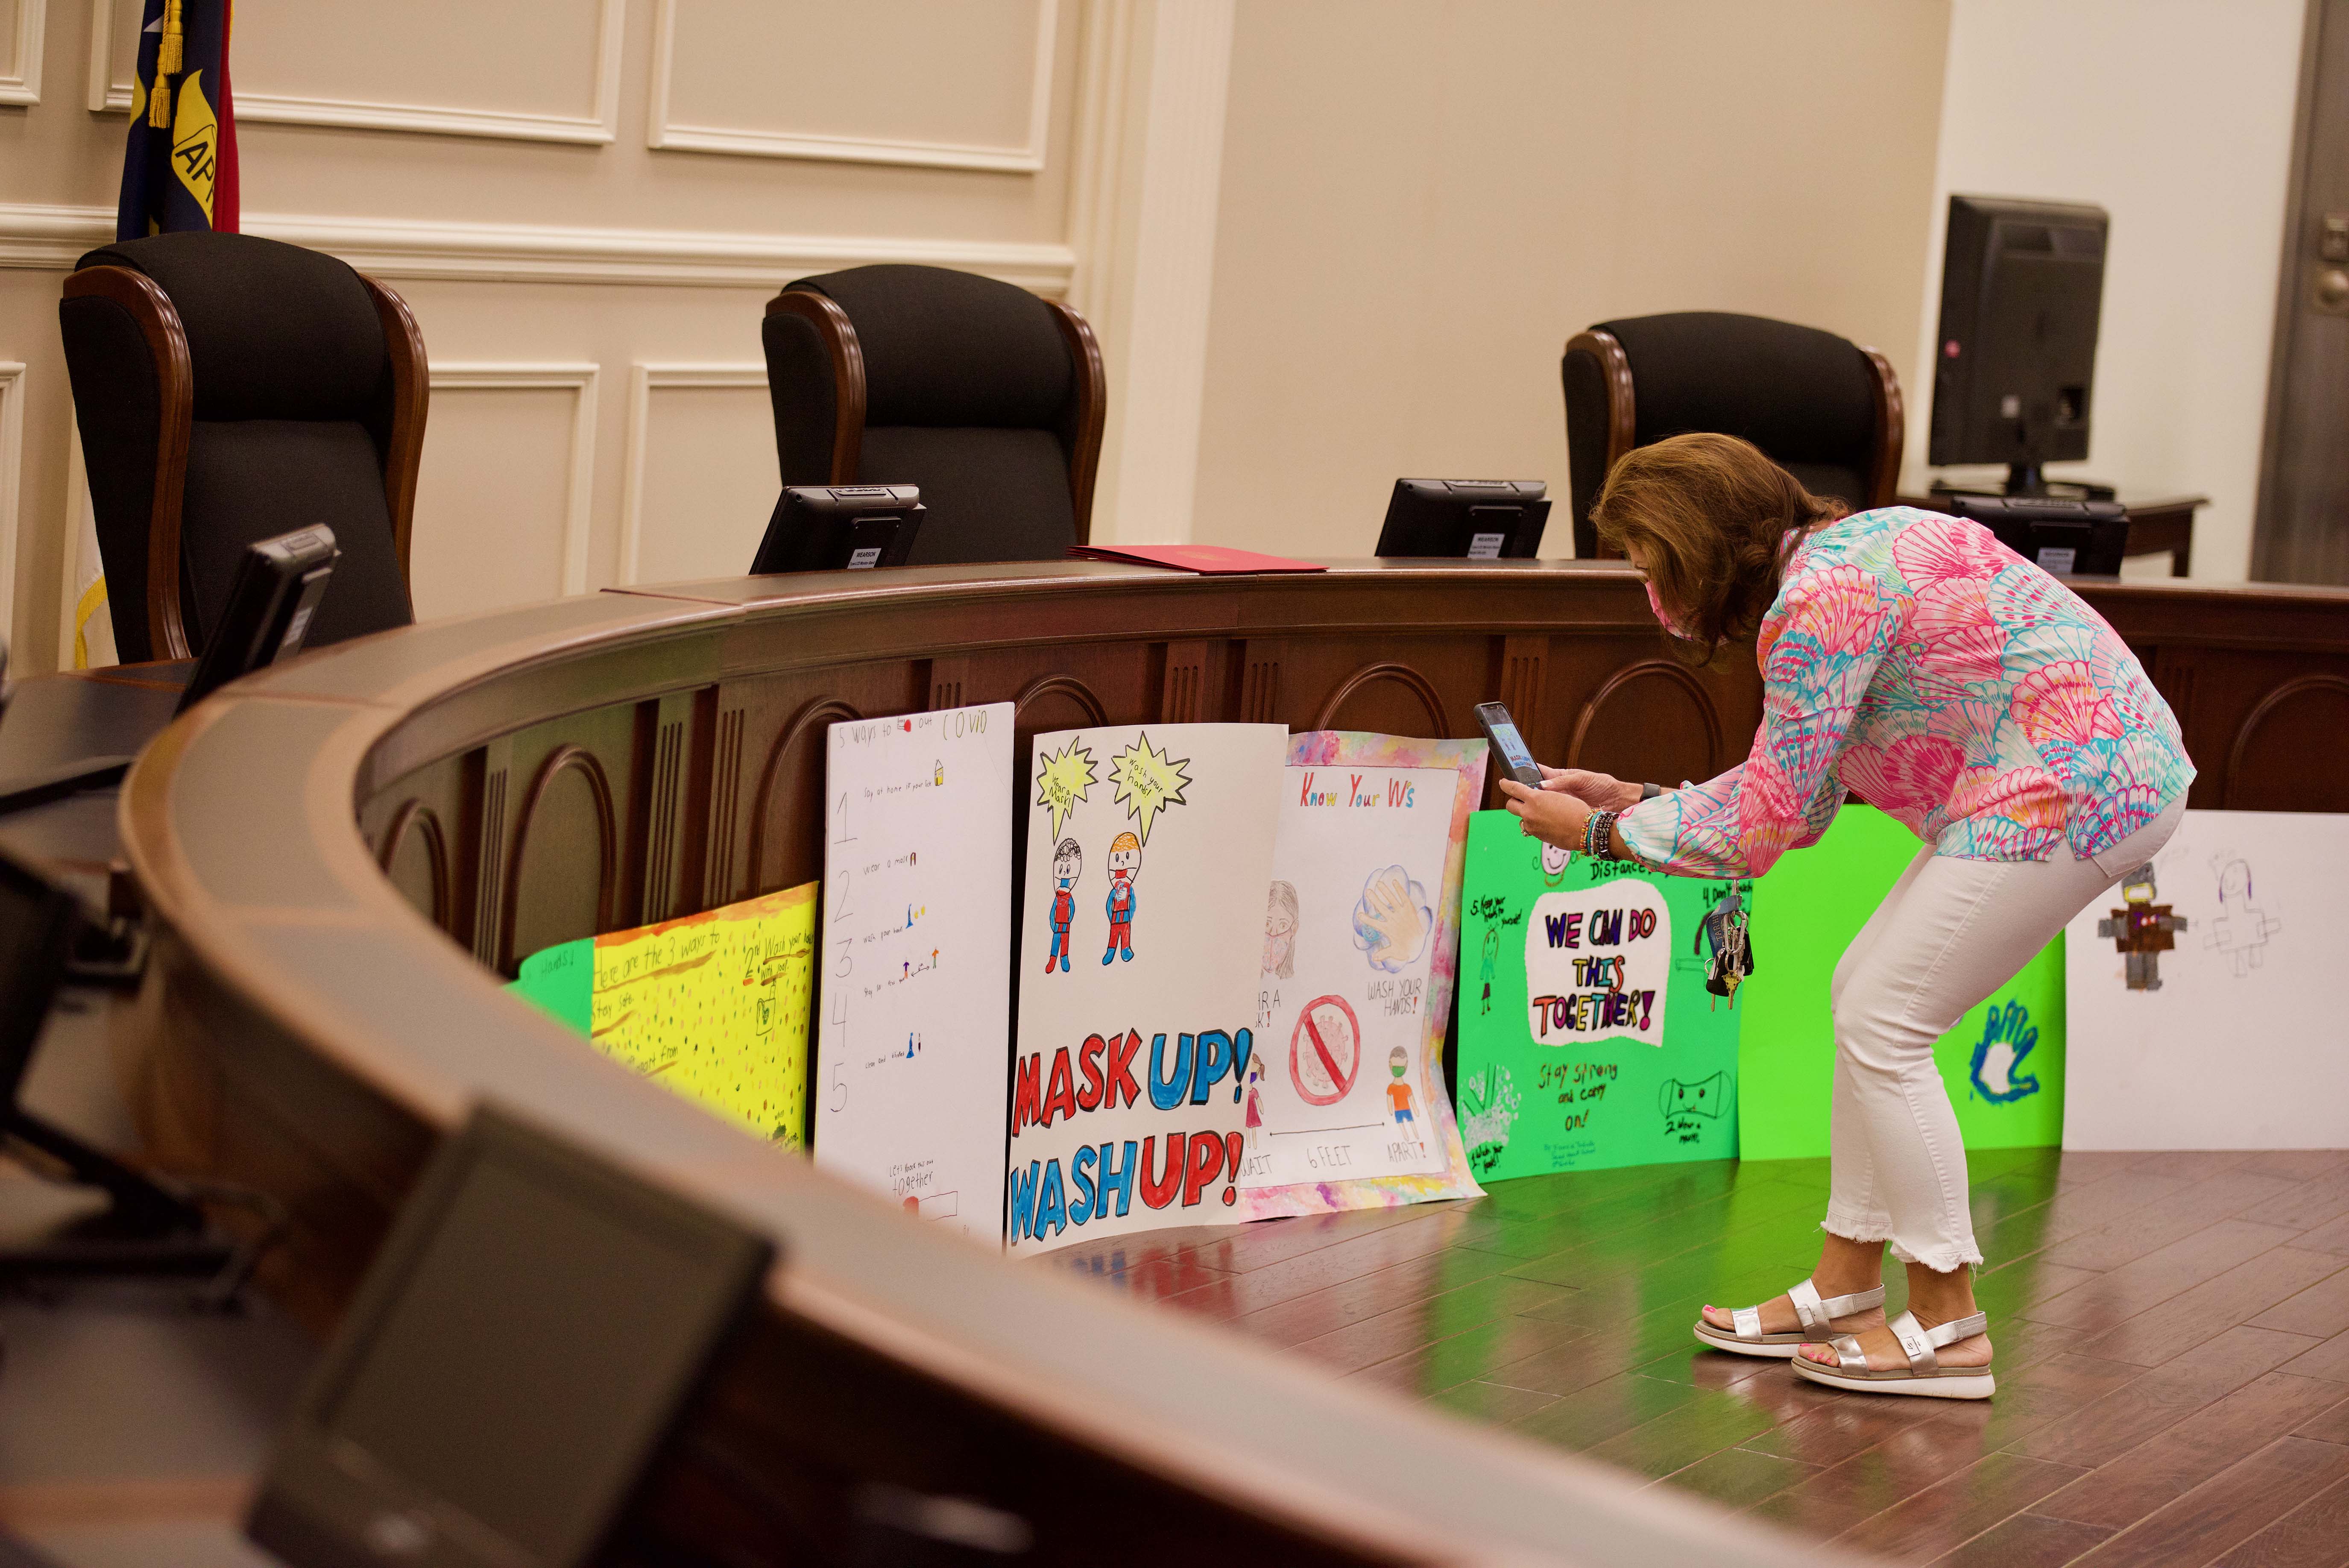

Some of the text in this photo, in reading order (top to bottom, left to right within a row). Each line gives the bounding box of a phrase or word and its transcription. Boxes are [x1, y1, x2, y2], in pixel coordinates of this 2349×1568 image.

[839, 727, 844, 748] 5
[883, 724, 891, 737] to
[919, 717, 933, 728] out
[1147, 777, 1163, 793] your
[1300, 772, 1415, 808] Know Your W's
[834, 792, 858, 844] 1
[877, 787, 883, 796] at
[913, 783, 923, 791] your
[834, 870, 853, 923] 2
[887, 859, 891, 868] a
[1545, 908, 1657, 949] WE CAN DO
[1713, 926, 1723, 941] TAR
[593, 924, 721, 989] Here are the 3 ways to
[835, 938, 852, 978] 3
[1572, 955, 1625, 993] THIS
[1273, 989, 1281, 1008] A
[1367, 977, 1422, 1001] WASH YOUR
[1384, 996, 1418, 1017] HANDS!
[832, 992, 847, 1048] 4
[1533, 990, 1656, 1038] TOGETHER!
[660, 1046, 679, 1062] from
[831, 1062, 847, 1113] 5
[878, 1054, 886, 1064] and
[1011, 1027, 1254, 1138] MASK UP!
[1538, 1063, 1569, 1089] Stay
[1558, 1089, 1574, 1104] and
[1241, 1142, 1427, 1177] WAIT 6 FEET APART!
[893, 1171, 933, 1198] together
[1010, 1130, 1245, 1247] WASH UP!
